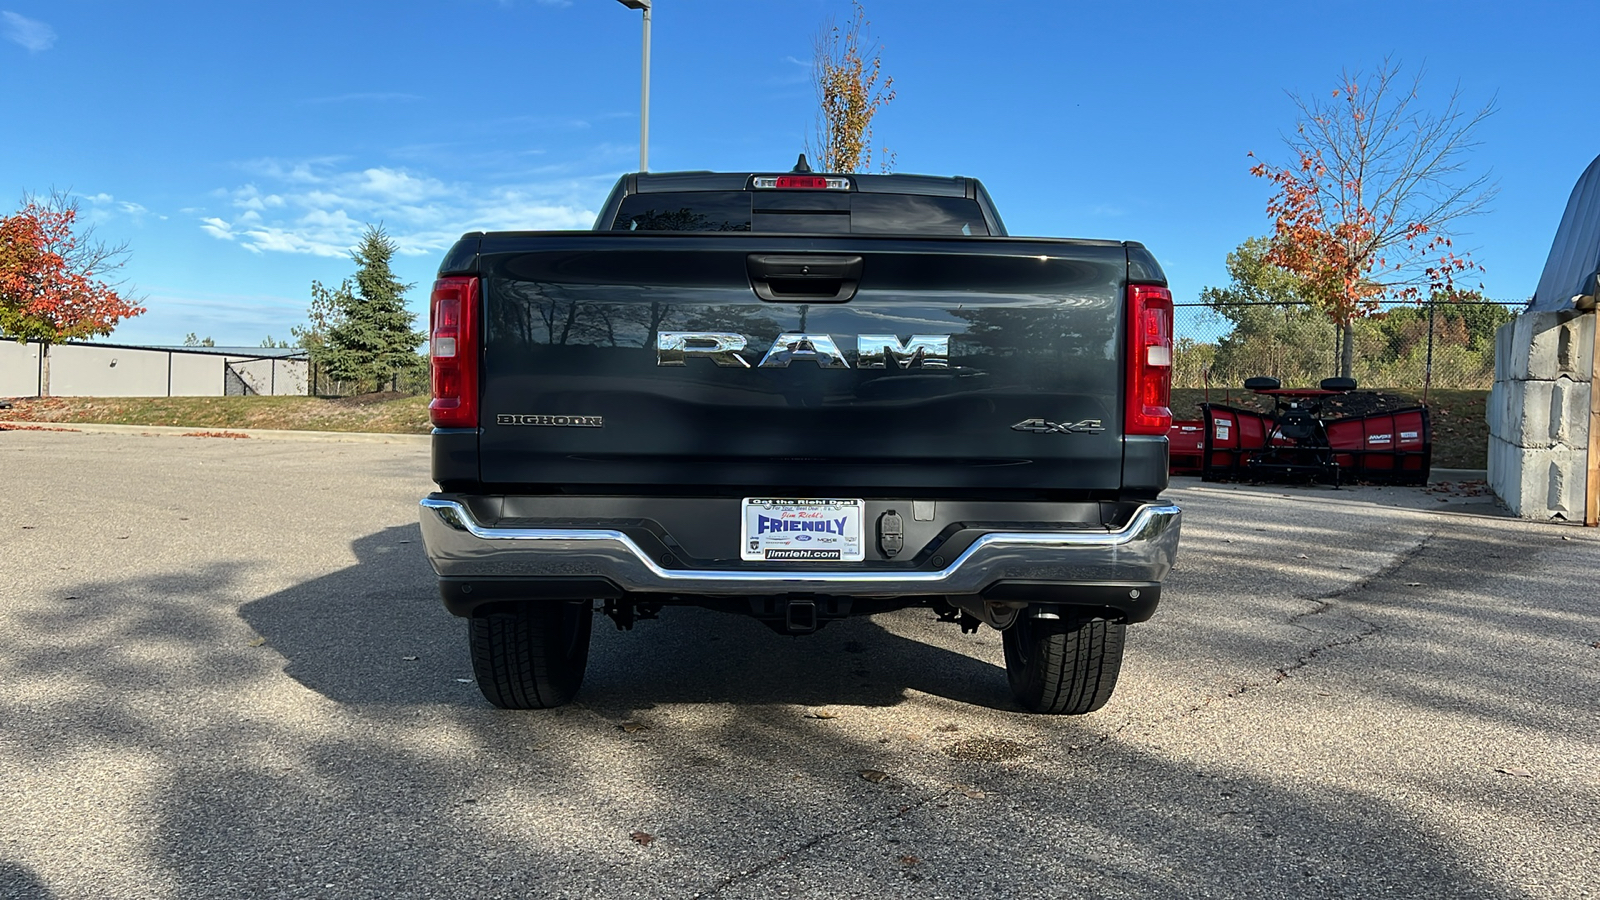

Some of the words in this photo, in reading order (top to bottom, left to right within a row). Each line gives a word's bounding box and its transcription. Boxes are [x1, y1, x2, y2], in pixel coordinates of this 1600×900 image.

[657, 331, 950, 370] RAM
[497, 413, 603, 428] BIGHORN
[781, 511, 796, 520] Jim
[758, 514, 848, 536] FRIENDLY
[767, 550, 840, 559] jimriehl.com
